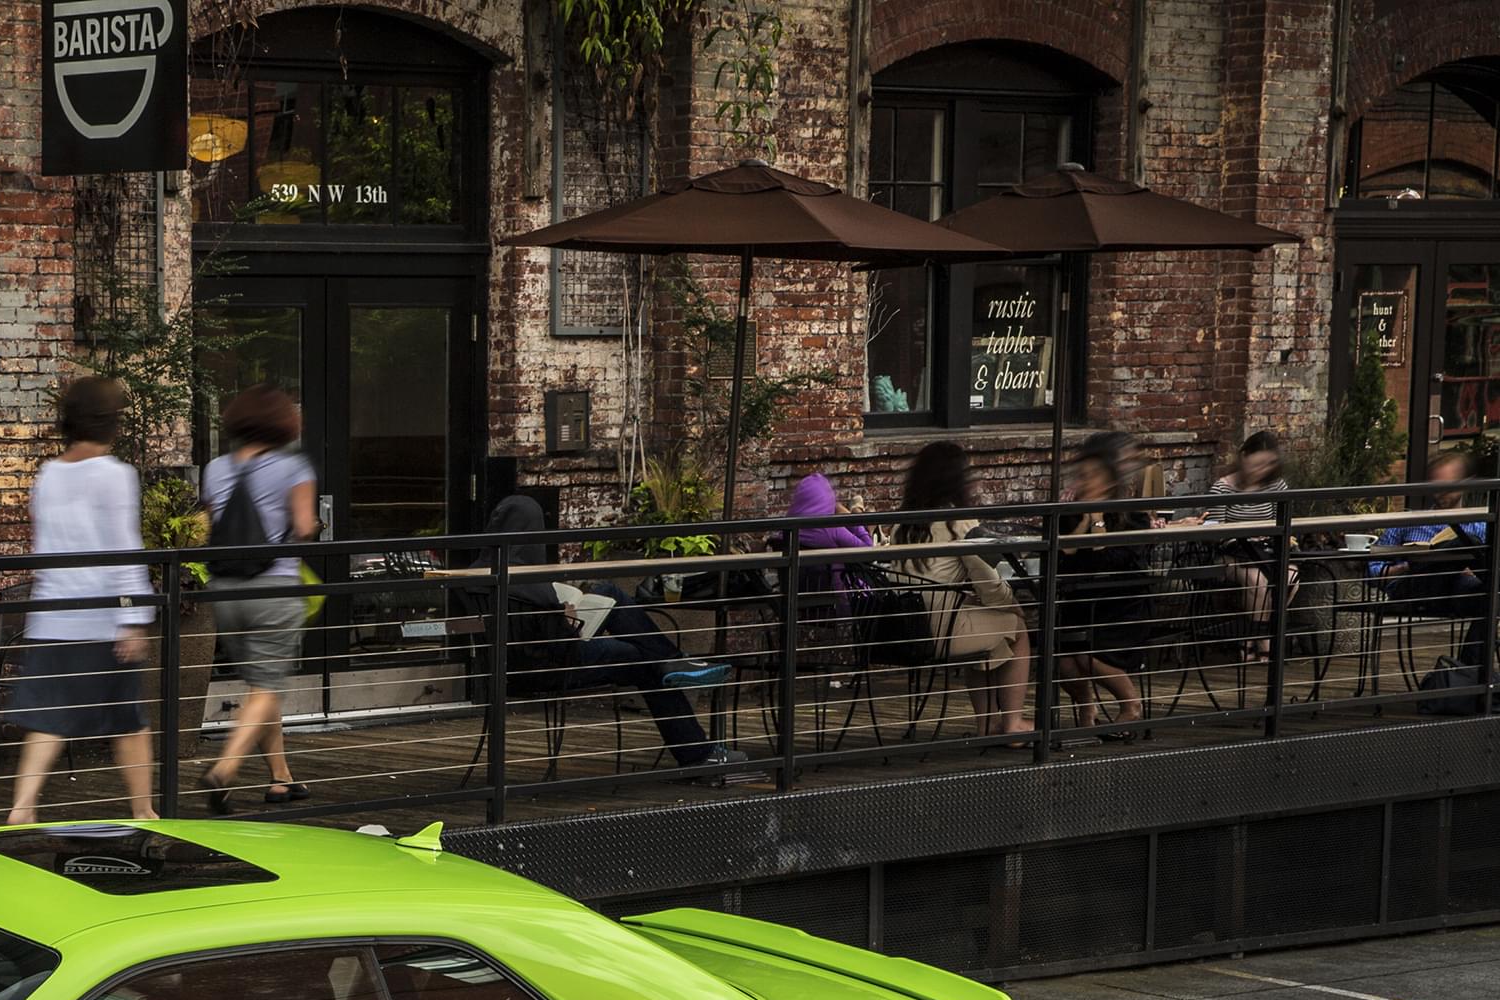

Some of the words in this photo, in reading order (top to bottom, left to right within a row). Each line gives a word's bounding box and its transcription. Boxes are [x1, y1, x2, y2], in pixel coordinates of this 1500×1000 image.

[53, 12, 157, 58] BARISTA
[271, 183, 299, 203] 539
[355, 184, 388, 204] 13th
[987, 291, 1036, 319] rustic
[1373, 302, 1393, 316] hunt
[1378, 318, 1387, 332] &
[986, 325, 1036, 354] tables
[974, 364, 989, 391] &
[994, 361, 1045, 390] chairs
